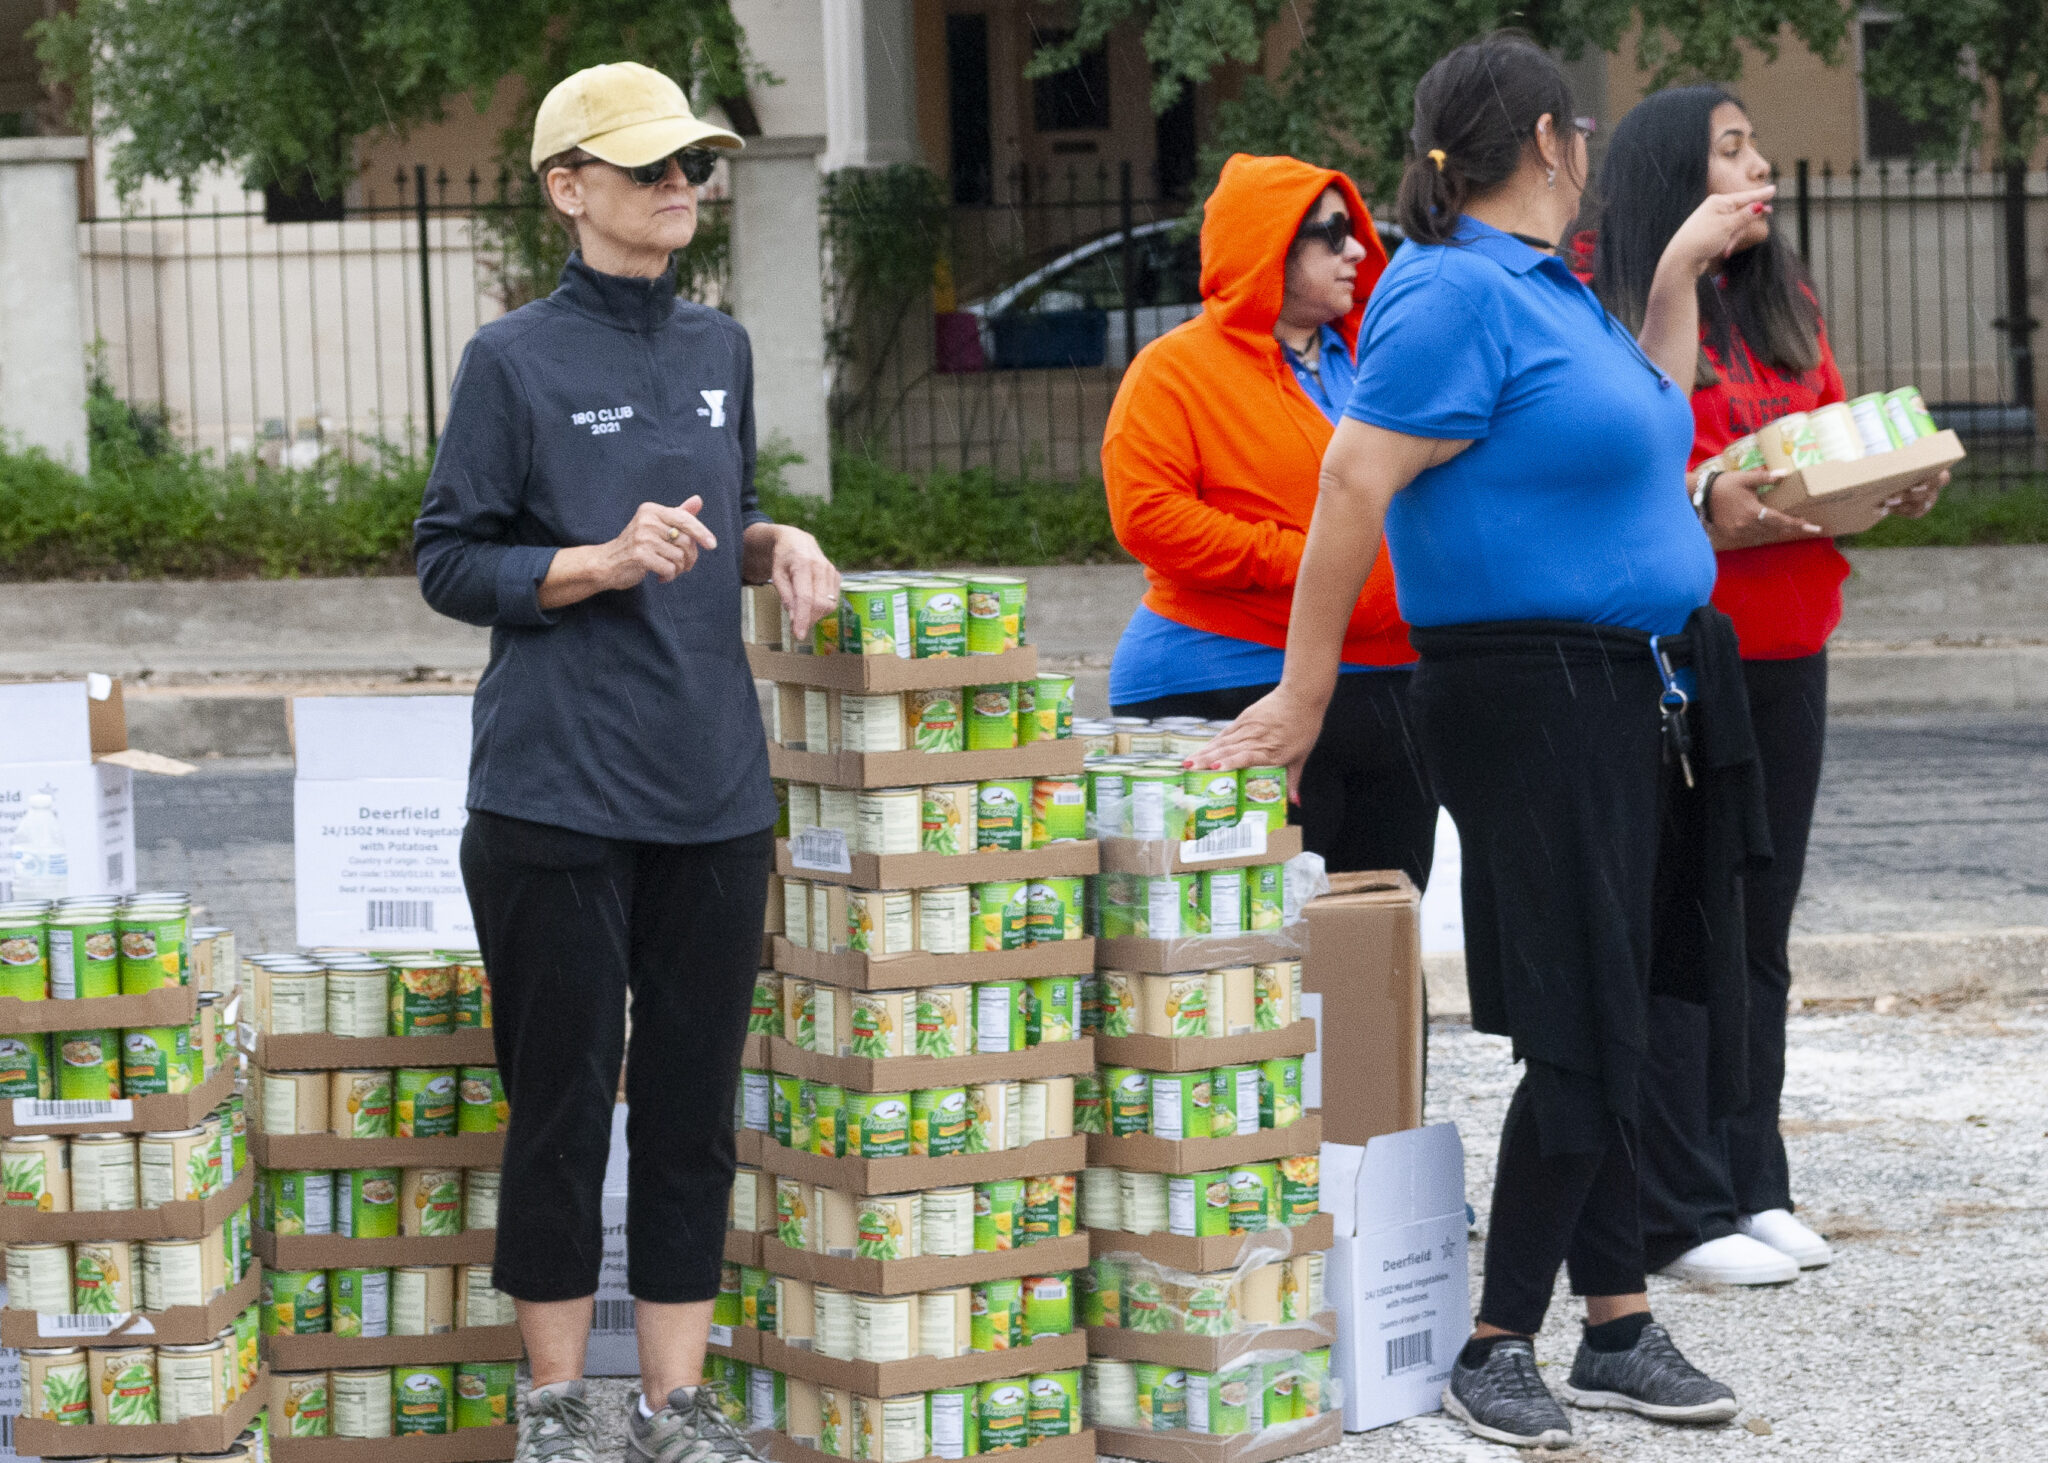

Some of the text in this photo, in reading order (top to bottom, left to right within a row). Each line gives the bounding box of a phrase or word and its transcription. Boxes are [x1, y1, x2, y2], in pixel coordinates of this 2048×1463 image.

[571, 406, 634, 425] 180 CLUB
[590, 421, 622, 435] 2021
[359, 806, 440, 820] Deerfield
[375, 826, 410, 836] Mixed
[413, 826, 463, 838] Vegetab
[359, 841, 439, 851] with Potatoes
[1382, 1248, 1432, 1273] Deerfield
